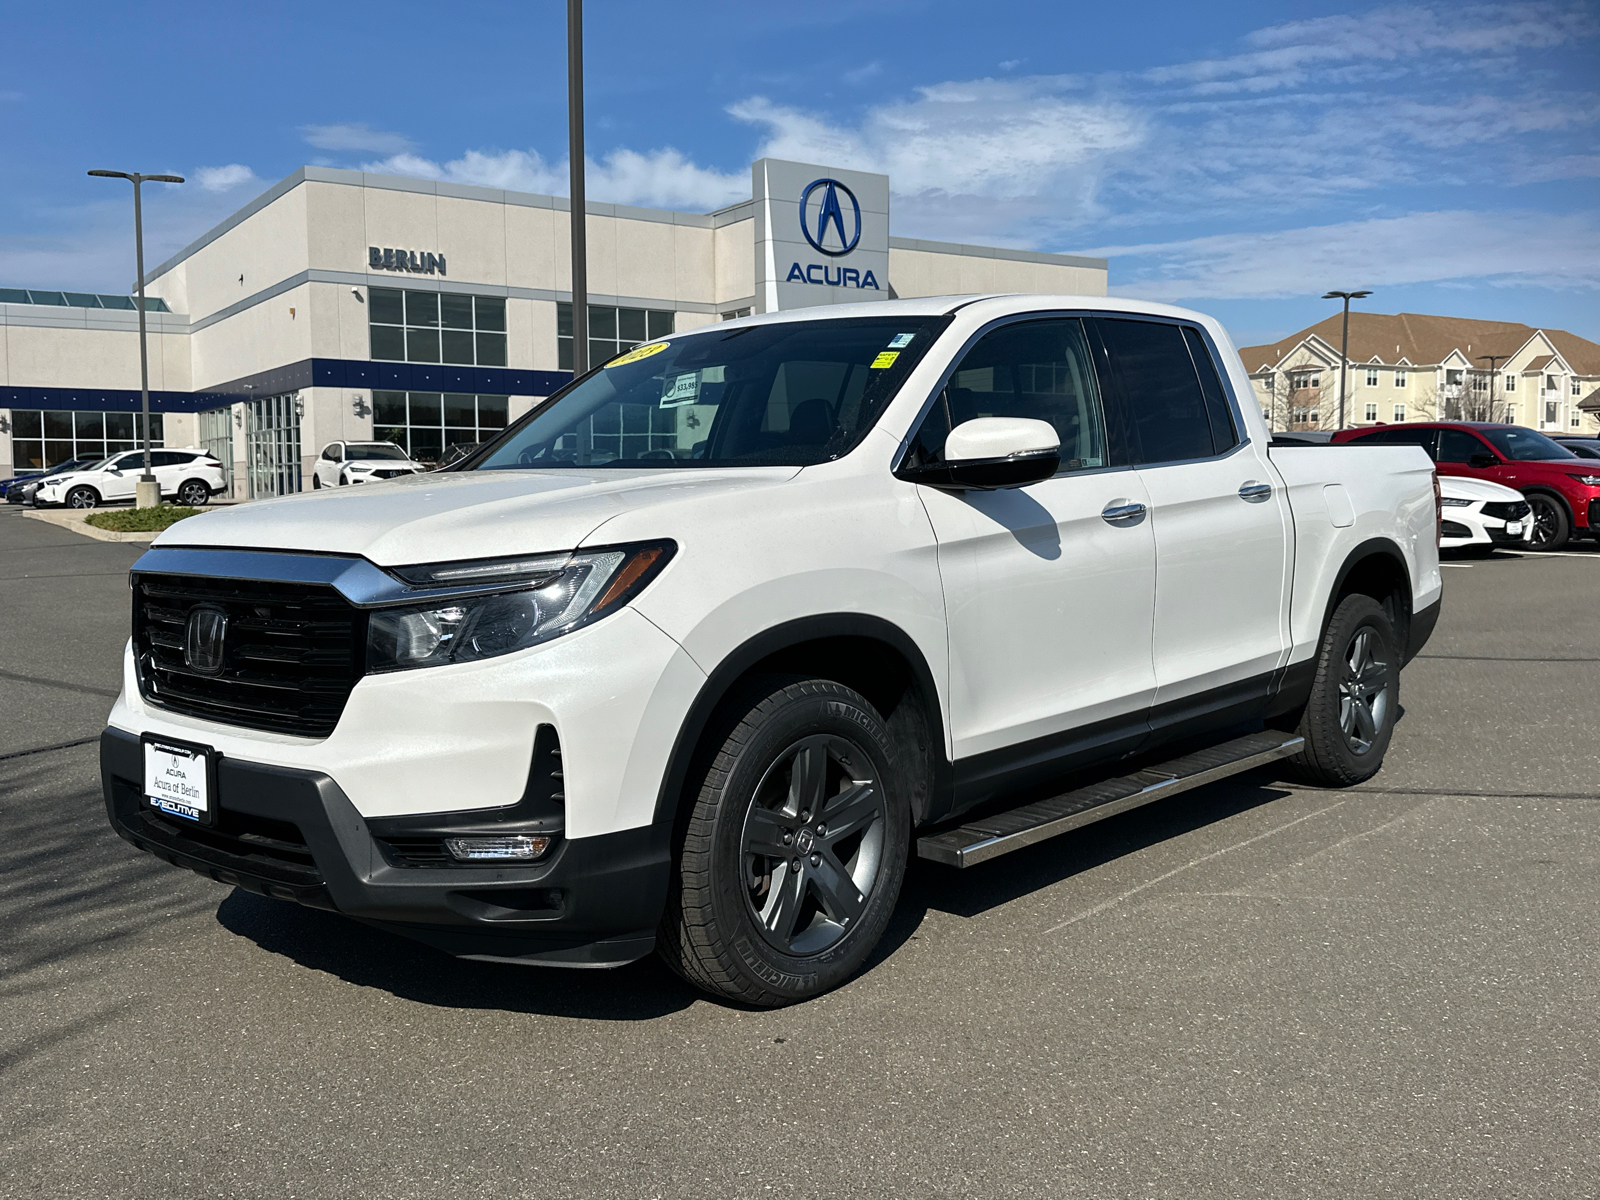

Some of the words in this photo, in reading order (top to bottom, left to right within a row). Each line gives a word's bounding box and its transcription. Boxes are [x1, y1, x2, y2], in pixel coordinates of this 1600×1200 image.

[368, 246, 446, 276] BERLIN
[786, 262, 880, 290] ACURA
[843, 705, 897, 761] MICHELIN
[154, 776, 172, 792] Acura
[172, 782, 180, 795] of
[181, 783, 200, 799] Berlin
[166, 768, 187, 780] ACURA
[150, 797, 200, 818] EXECUTIVE
[731, 937, 801, 991] MICHELIN
